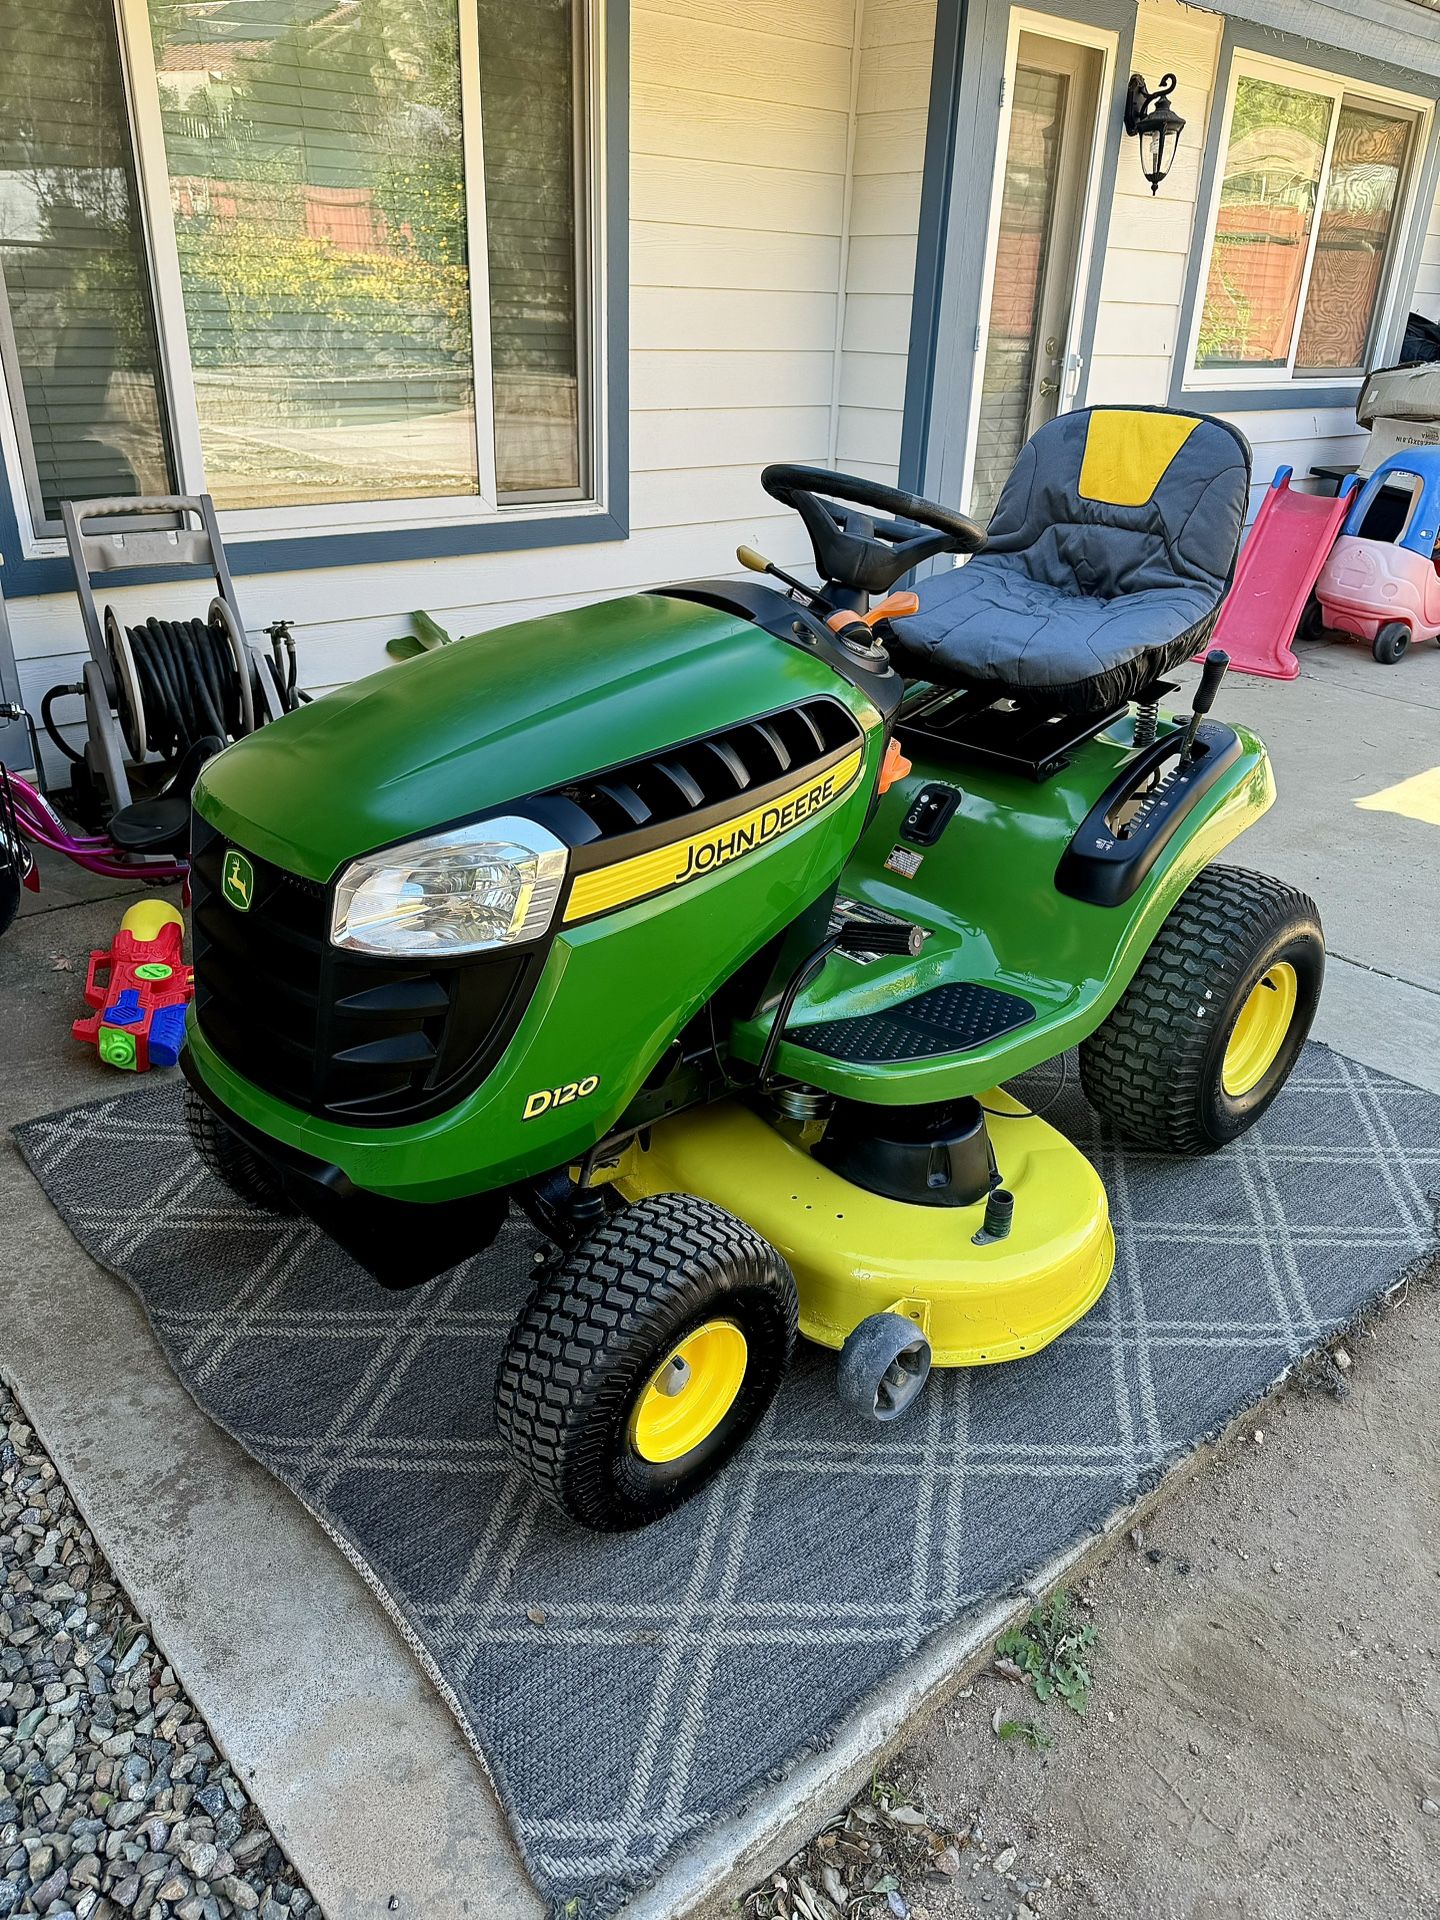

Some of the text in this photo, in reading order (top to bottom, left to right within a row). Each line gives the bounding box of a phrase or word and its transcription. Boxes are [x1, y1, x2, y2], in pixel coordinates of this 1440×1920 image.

[675, 775, 835, 880] JOHN DEERE
[522, 1074, 600, 1120] D120
